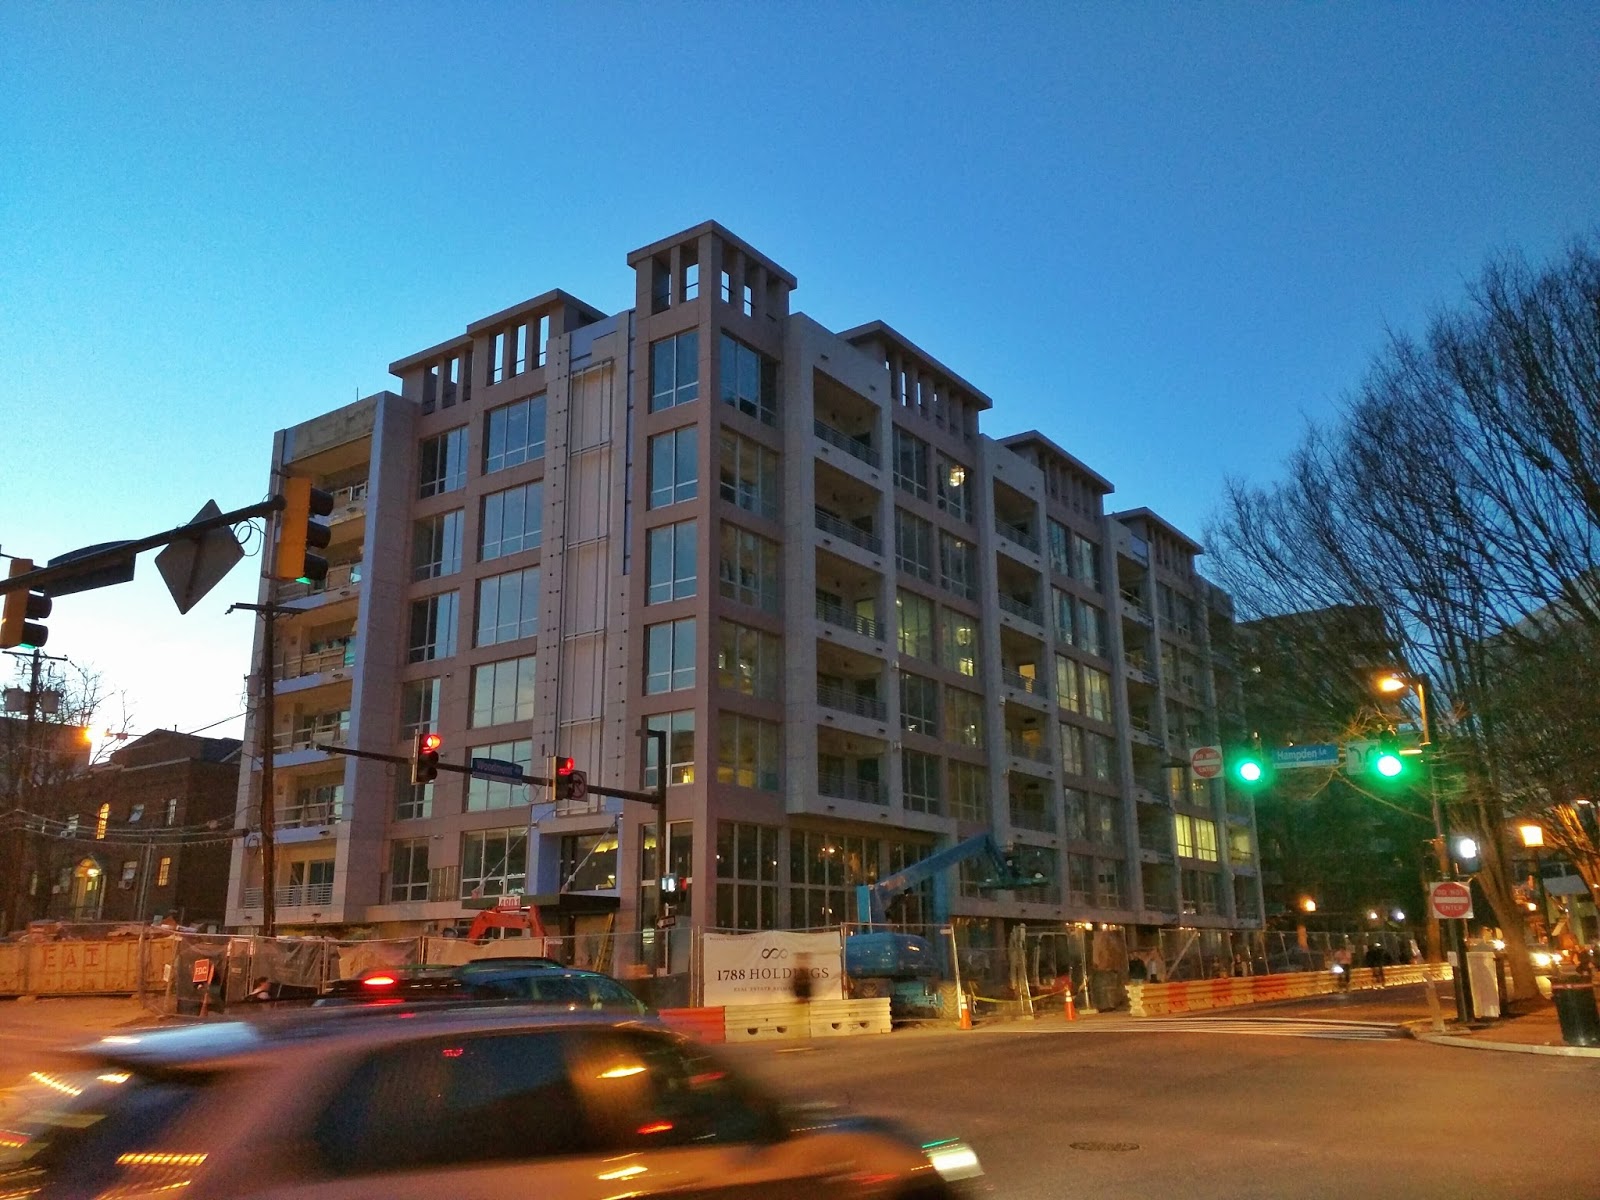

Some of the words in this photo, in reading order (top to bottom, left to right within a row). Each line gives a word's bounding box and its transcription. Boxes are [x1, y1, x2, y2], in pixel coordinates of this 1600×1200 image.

[1277, 748, 1318, 761] Hampden
[195, 966, 207, 975] FDC
[717, 969, 746, 981] 1788
